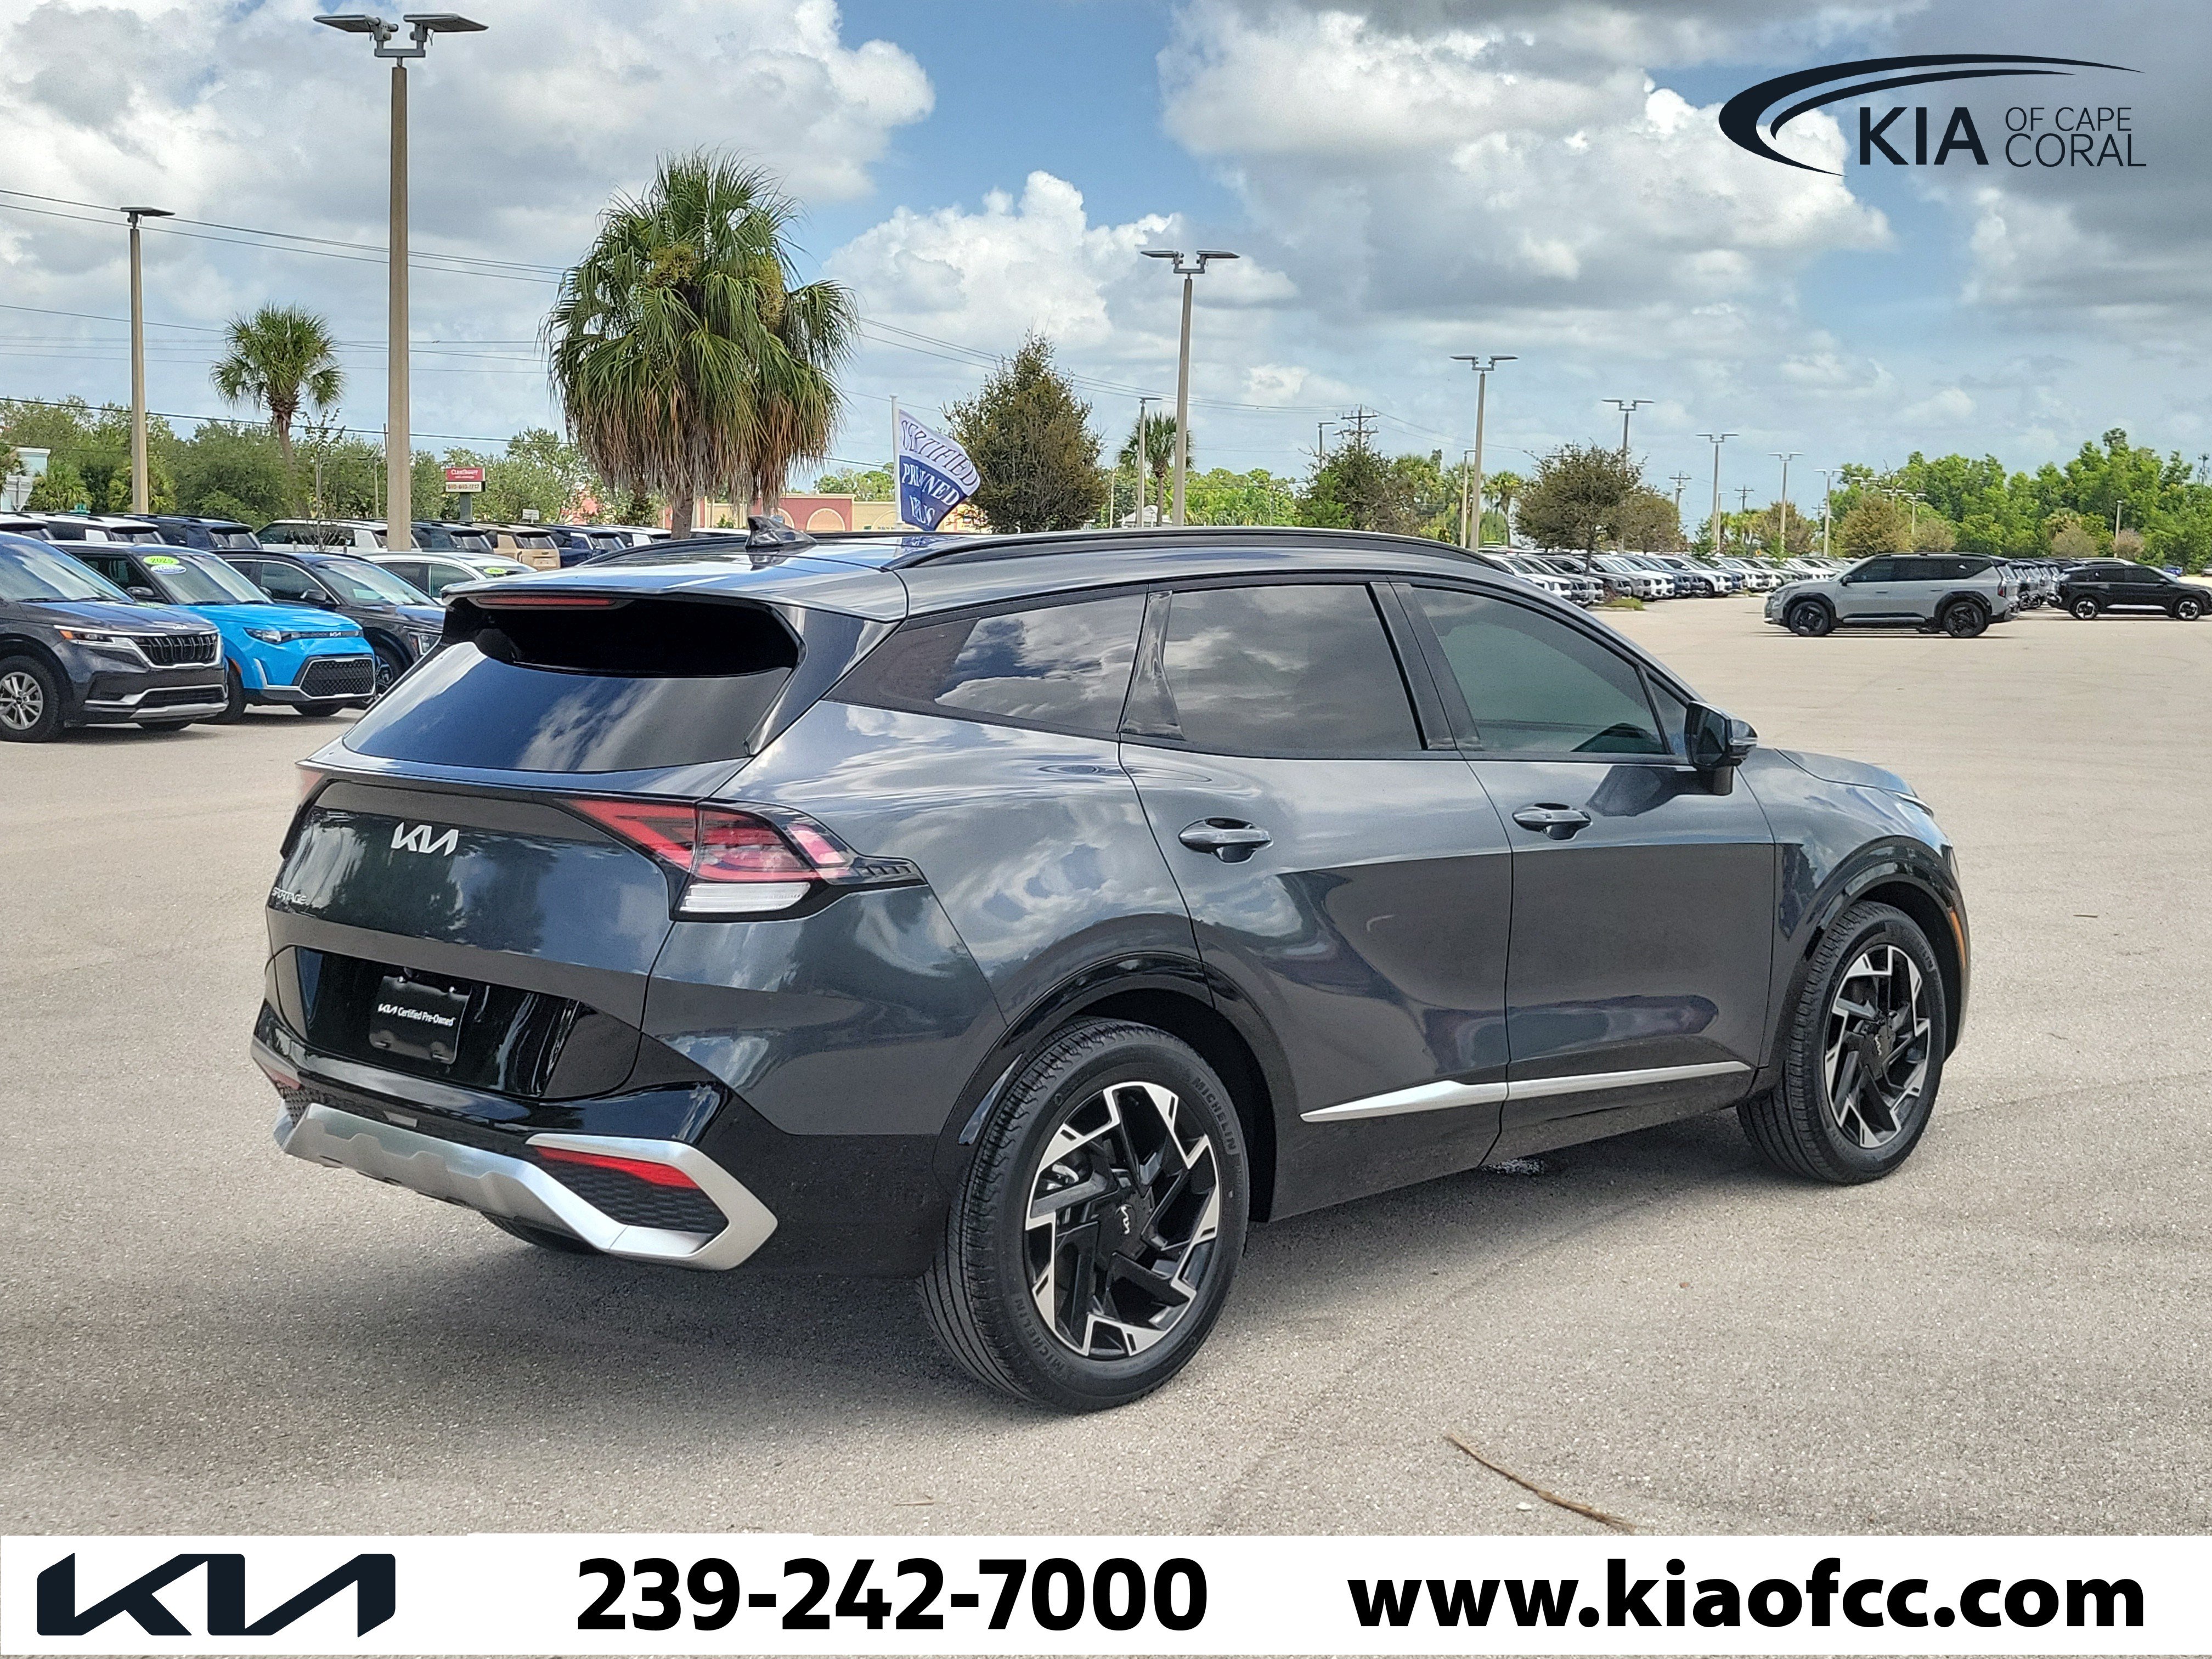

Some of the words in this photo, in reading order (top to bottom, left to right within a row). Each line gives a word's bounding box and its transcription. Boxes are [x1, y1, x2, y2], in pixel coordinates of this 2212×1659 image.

[391, 822, 459, 856] KIA
[377, 1003, 398, 1015] KIA
[398, 1007, 423, 1020] Certified
[422, 1011, 455, 1027] Pre-Owned
[1192, 1077, 1237, 1150] MICHELIN
